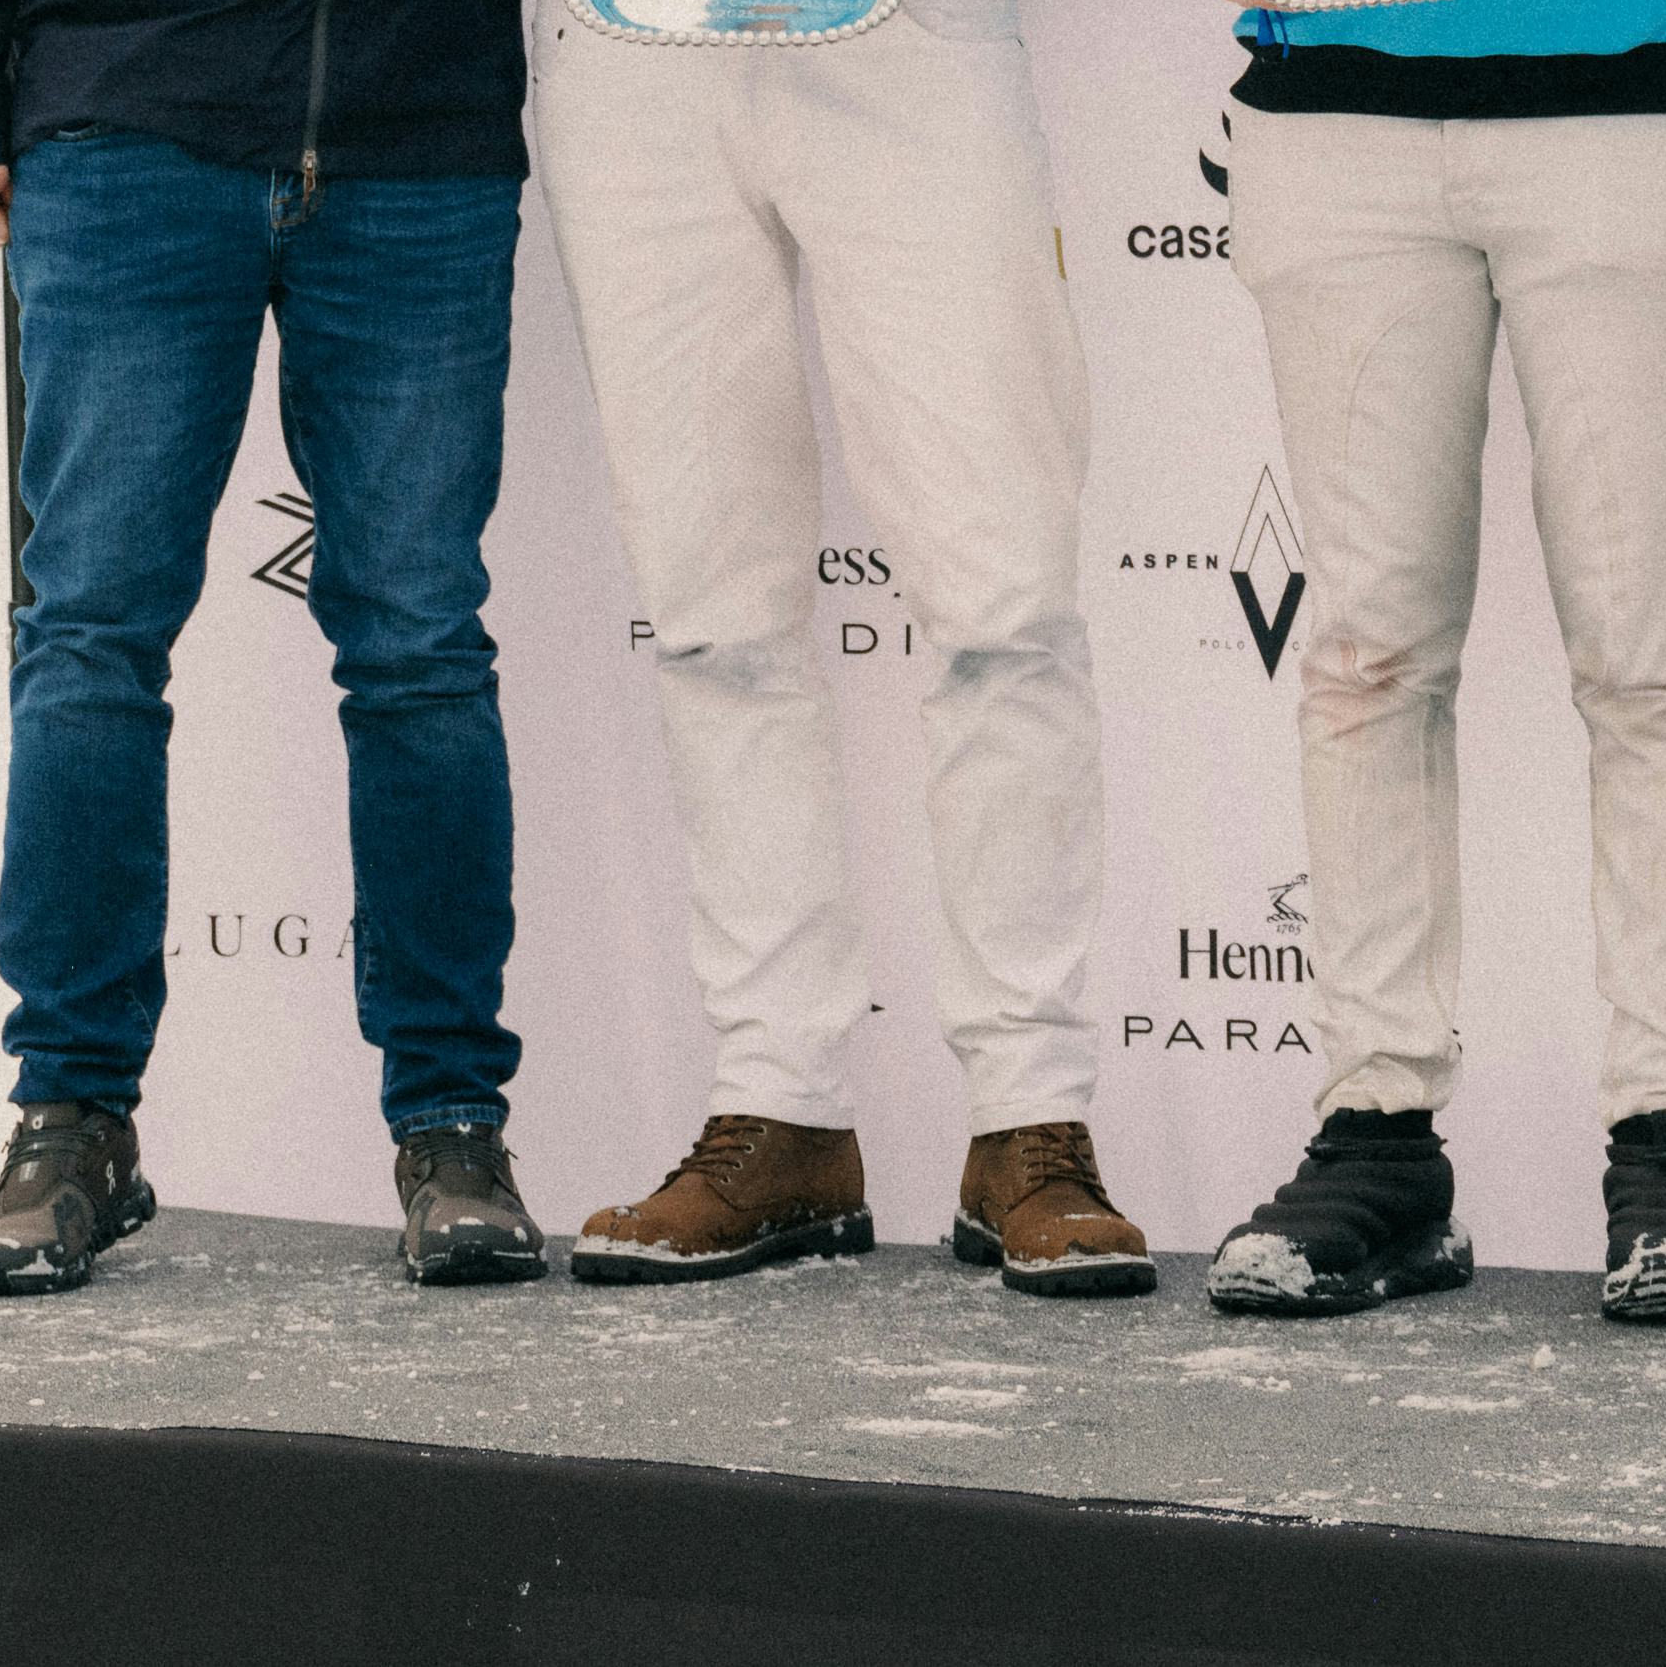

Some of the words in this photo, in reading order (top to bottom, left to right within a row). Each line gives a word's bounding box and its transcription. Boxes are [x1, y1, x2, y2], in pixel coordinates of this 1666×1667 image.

[1120, 553, 1218, 569] ASPEN
[1199, 639, 1245, 651] POLO
[1179, 928, 1315, 983] Henn
[1124, 1015, 1312, 1055] PARA
